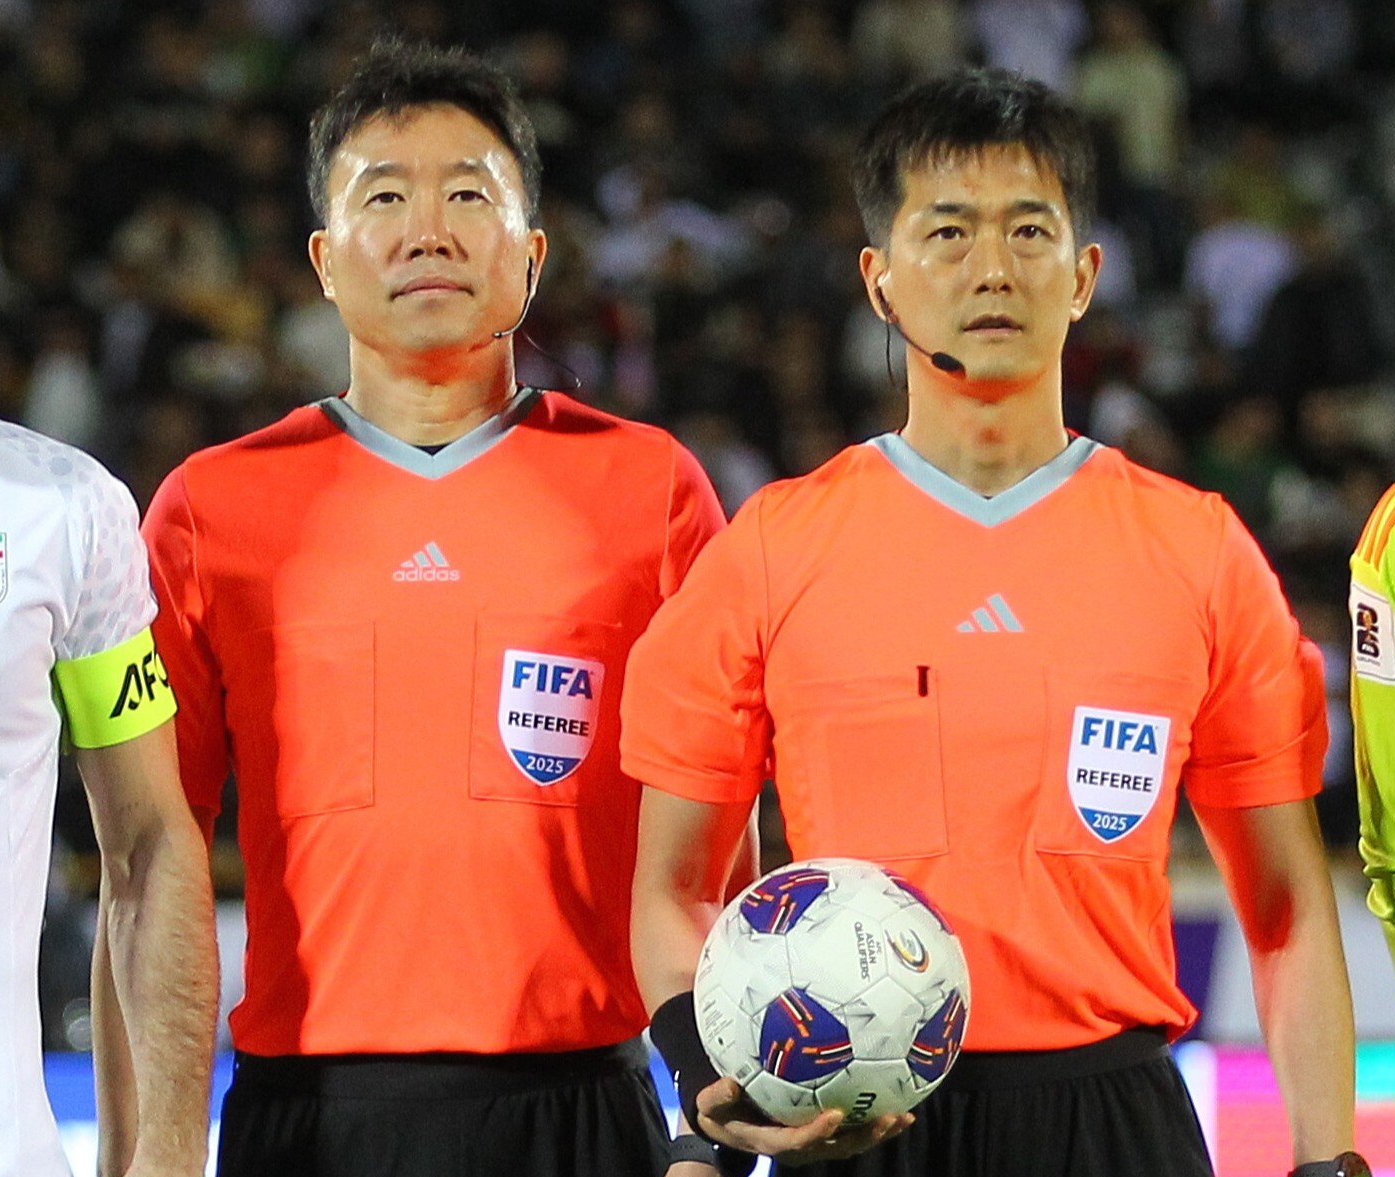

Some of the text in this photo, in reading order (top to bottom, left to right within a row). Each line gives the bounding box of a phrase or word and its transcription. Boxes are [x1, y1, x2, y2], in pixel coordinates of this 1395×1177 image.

[392, 567, 461, 582] adidas
[511, 659, 594, 700] FIFA
[508, 711, 591, 738] REFEREE
[1080, 715, 1158, 756] FIFA
[526, 756, 565, 775] 2025
[1075, 767, 1154, 793] REFEREE
[1092, 813, 1128, 832] 2025
[854, 921, 871, 983] QUALIFIERS
[865, 932, 877, 965] ASIAN
